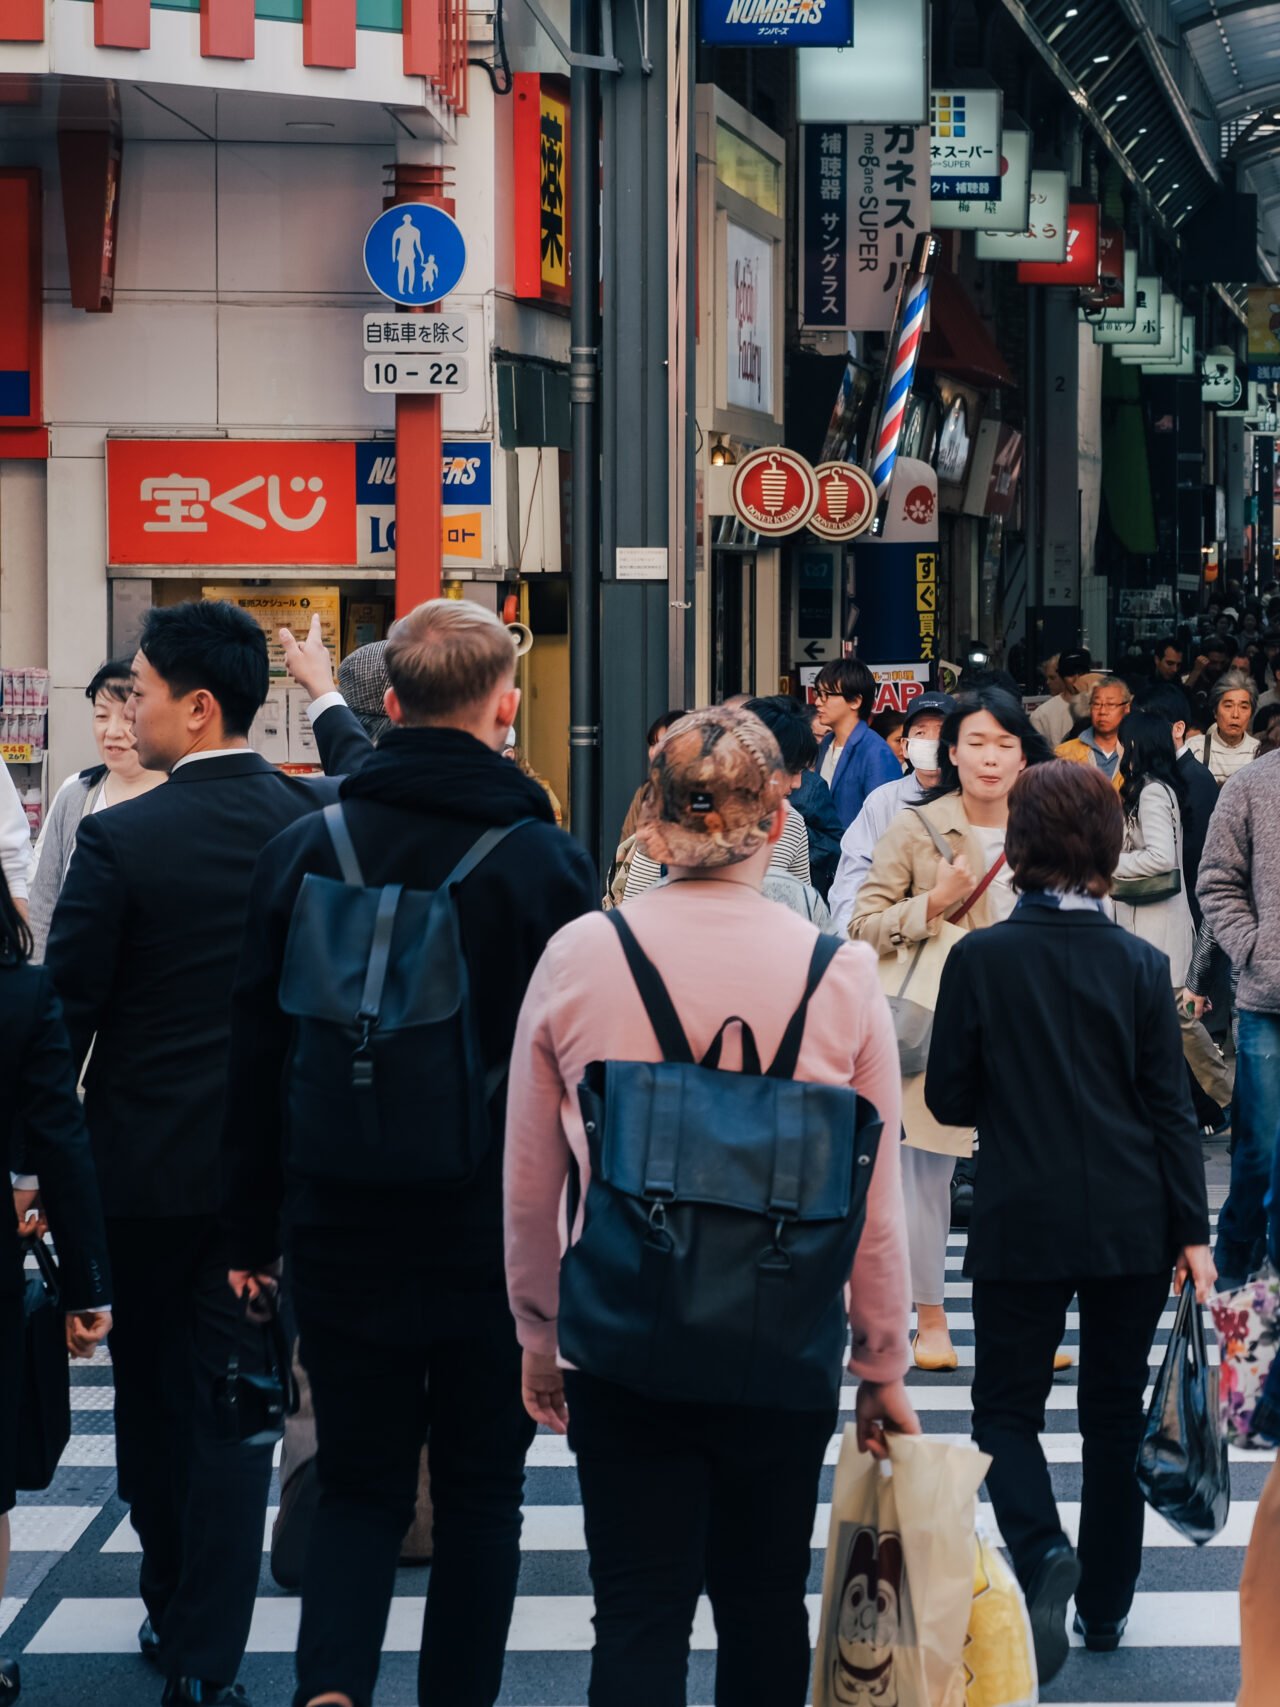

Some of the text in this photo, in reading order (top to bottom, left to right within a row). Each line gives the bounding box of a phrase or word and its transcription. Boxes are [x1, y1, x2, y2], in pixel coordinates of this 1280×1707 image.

[725, 0, 826, 24] NUMBERS
[820, 133, 843, 314] 補聴器 サングラス
[367, 322, 464, 343] 自転車を除く
[375, 363, 397, 384] 10
[430, 363, 458, 384] 22
[140, 473, 327, 532] 宝くじ
[919, 556, 935, 660] すぐ買え
